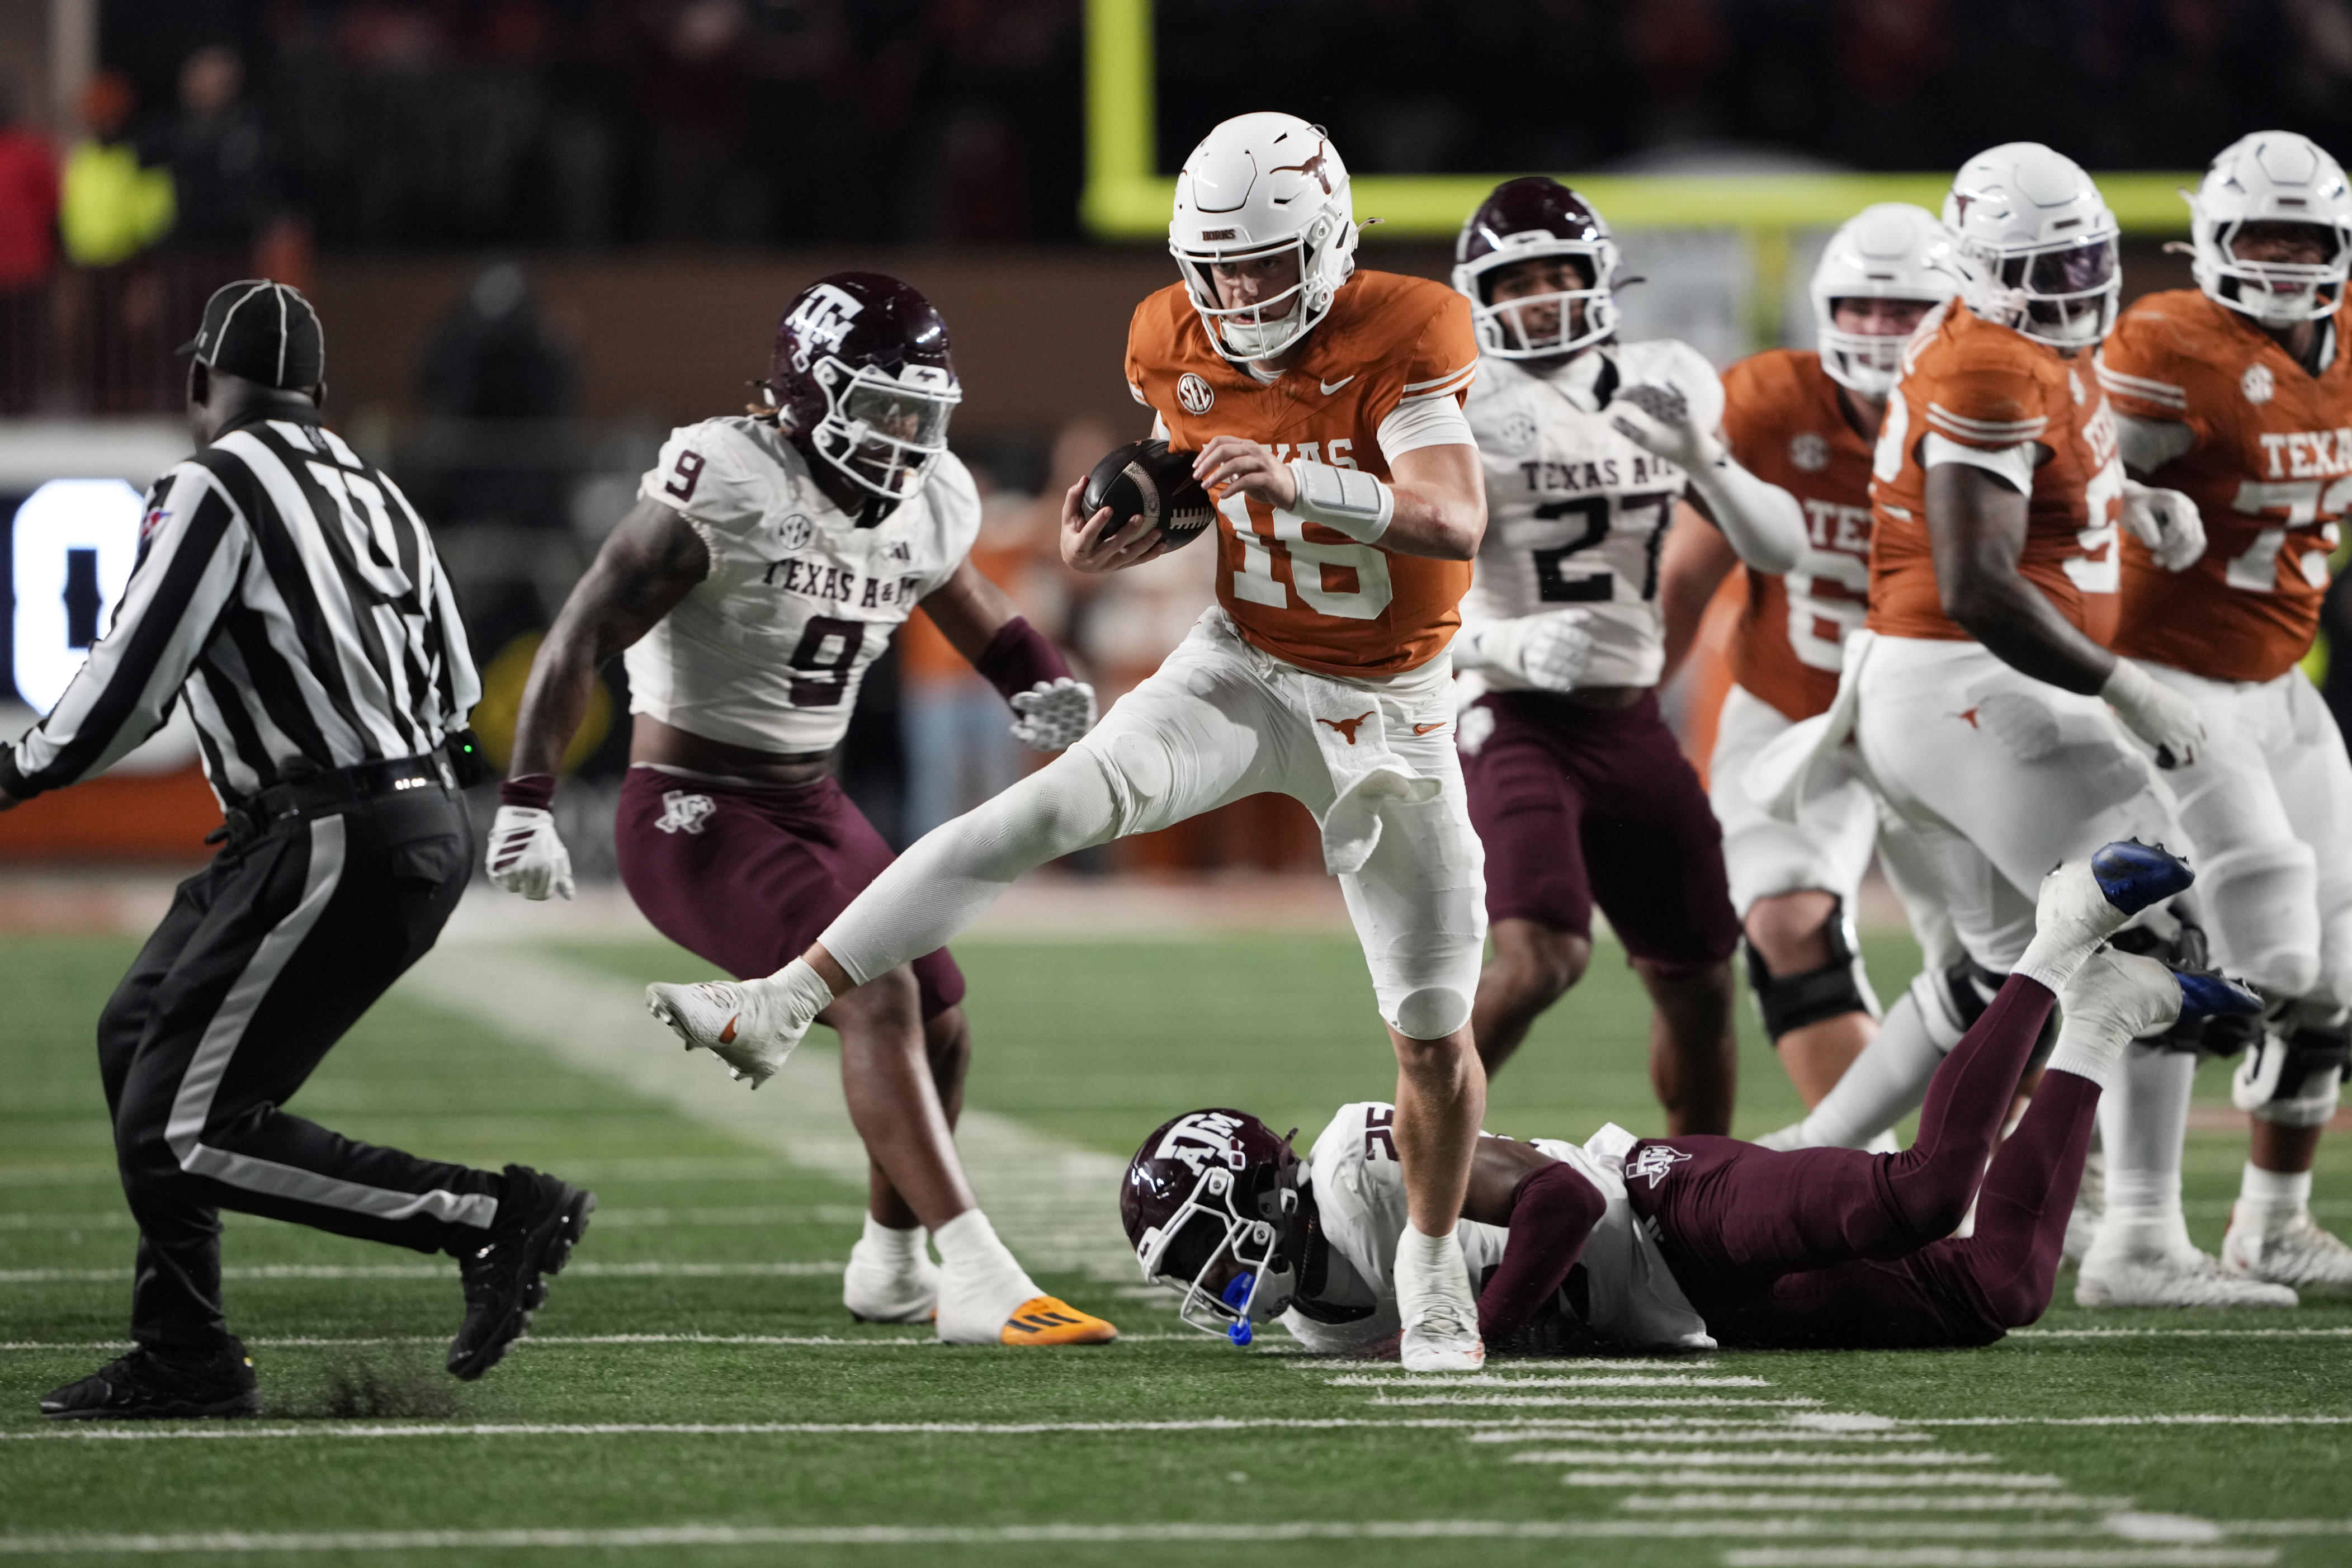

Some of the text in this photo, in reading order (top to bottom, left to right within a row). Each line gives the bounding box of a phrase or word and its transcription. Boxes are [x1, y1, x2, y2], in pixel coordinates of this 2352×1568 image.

[1202, 229, 1236, 241] HORNS
[1179, 375, 1212, 412] SEC
[665, 450, 706, 502] 9
[1519, 458, 1619, 491] TEXAS
[1217, 490, 1392, 620] 16
[1534, 494, 1671, 602] 27
[763, 559, 854, 602] TEXAS
[788, 615, 865, 707] 9
